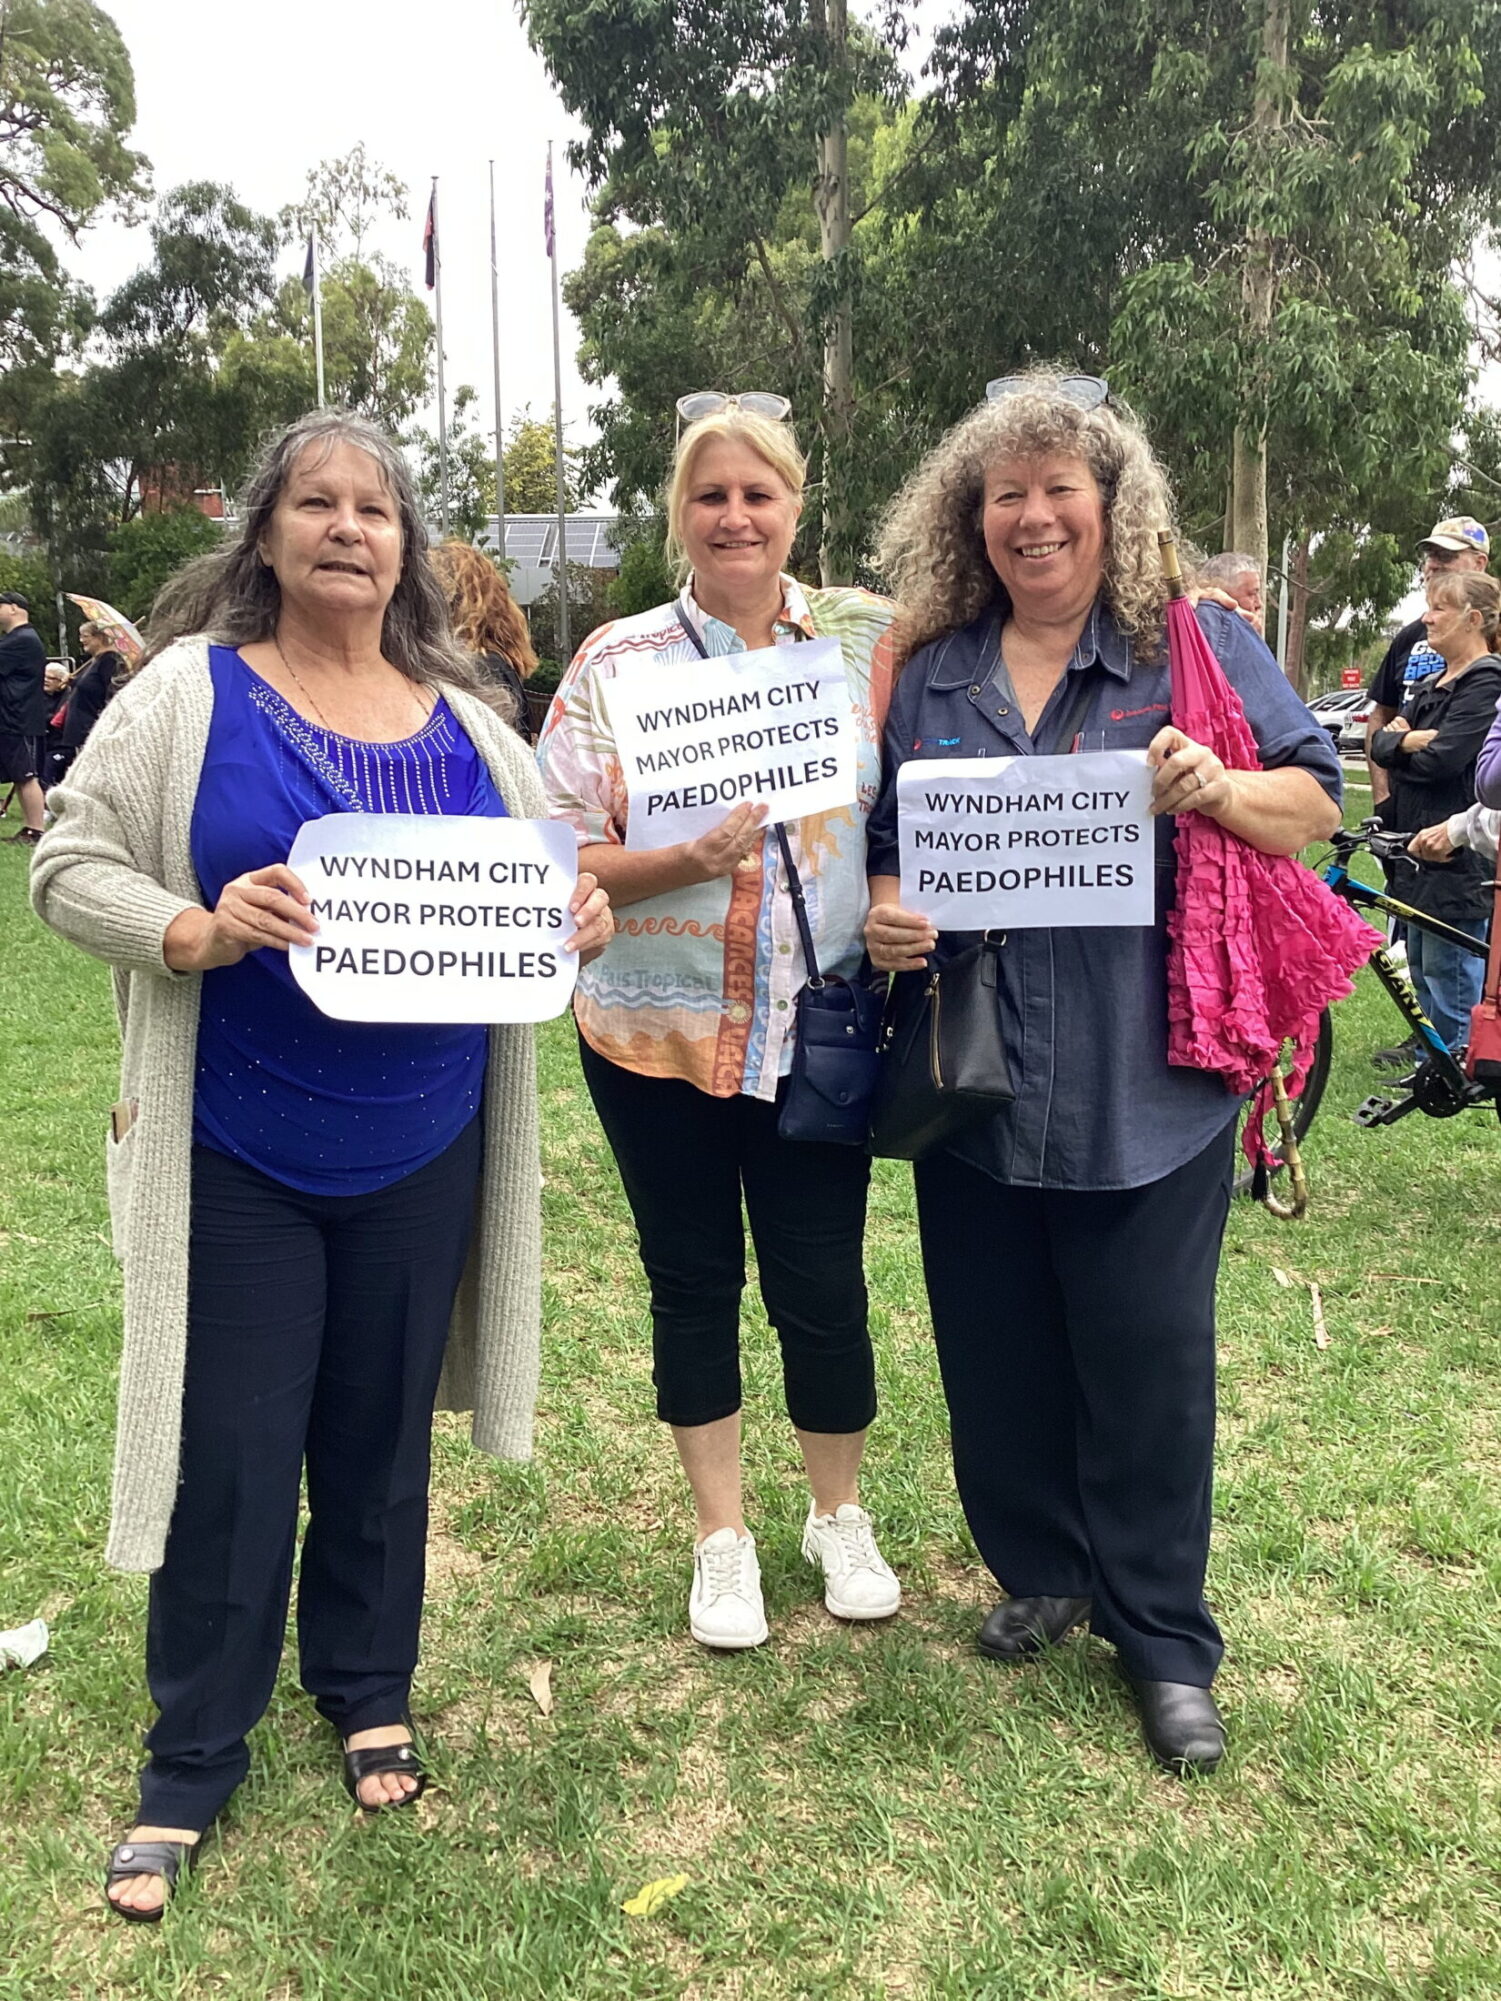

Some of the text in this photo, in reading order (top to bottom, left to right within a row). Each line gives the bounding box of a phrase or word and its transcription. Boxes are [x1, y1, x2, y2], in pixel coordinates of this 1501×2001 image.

[637, 681, 820, 732] WYNDHAM CITY
[636, 741, 715, 775] MAYOR
[719, 717, 839, 756] PROTECTS
[647, 757, 838, 816] PAEDOPHILES
[925, 790, 1130, 815] WYNDHAM CITY
[915, 823, 1140, 852] MAYOR PROTECTS
[320, 856, 549, 885] WYNDHAM CITY
[918, 864, 1134, 893] PAEDOPHILES
[311, 899, 562, 929] MAYOR PROTECTS
[316, 946, 557, 978] PAEDOPHILES
[1374, 949, 1429, 1023] GIANT
